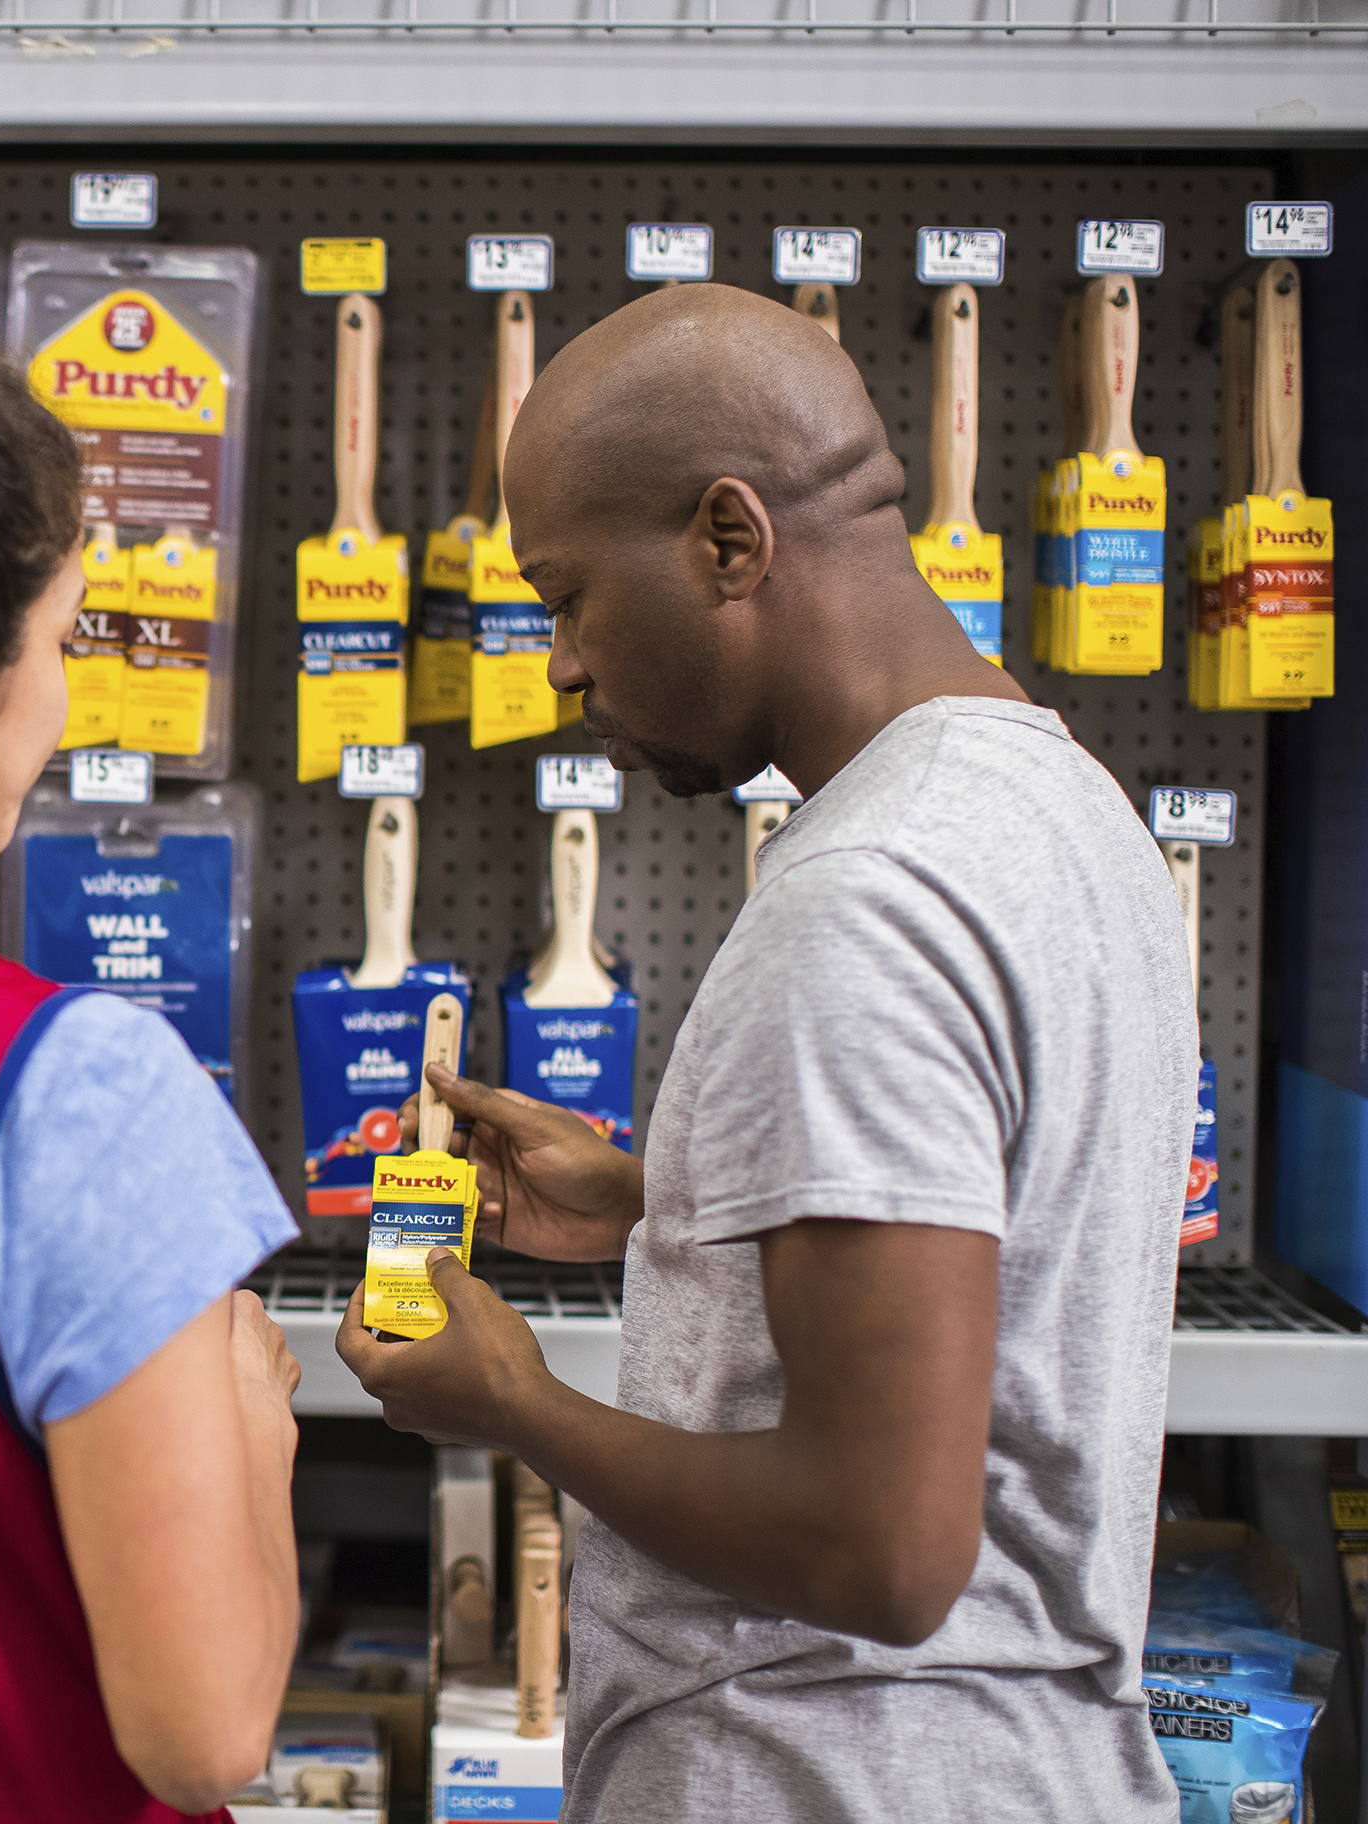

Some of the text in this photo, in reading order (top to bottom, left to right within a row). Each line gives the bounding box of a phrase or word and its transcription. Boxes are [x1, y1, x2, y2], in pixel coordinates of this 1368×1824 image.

[53, 360, 207, 409] Purdy
[1088, 492, 1159, 517] Purdy
[1255, 527, 1328, 548] Purdy
[1253, 568, 1325, 586] SYNTOX
[307, 577, 389, 604] Purdy
[76, 613, 120, 640] XL
[137, 618, 183, 647] XL
[81, 869, 163, 901] valspar
[87, 914, 169, 939] WALL
[92, 955, 162, 979] TRIM
[378, 1172, 459, 1192] Purdy
[373, 1212, 456, 1226] CLEARCUT
[373, 1232, 399, 1242] RIGIDE
[414, 1280, 433, 1288] aptit
[1151, 1714, 1232, 1741] AINERS
[449, 1796, 516, 1810] DECKS
